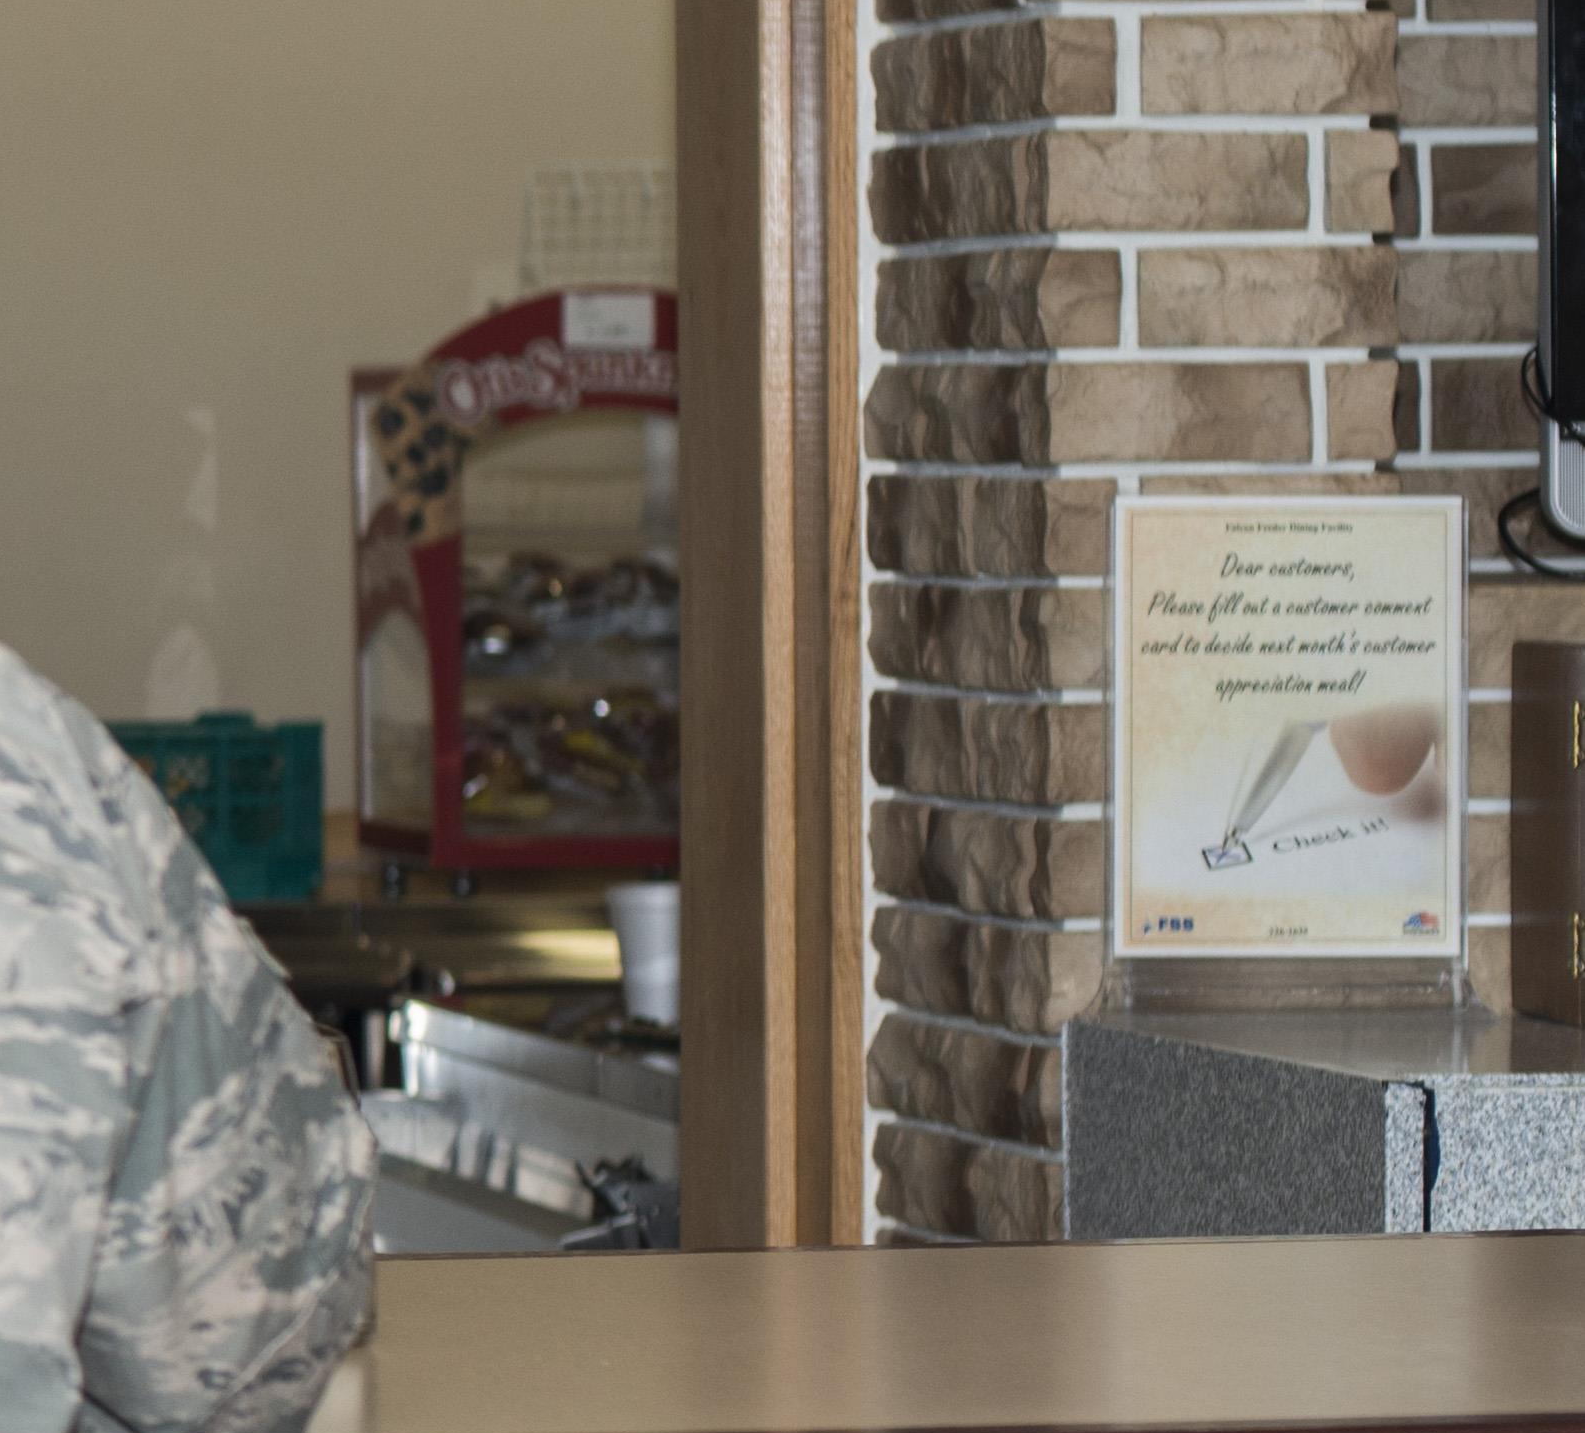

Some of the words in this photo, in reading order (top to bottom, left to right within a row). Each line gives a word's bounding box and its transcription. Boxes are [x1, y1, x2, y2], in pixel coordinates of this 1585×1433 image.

[1221, 552, 1263, 578] Dear
[1269, 557, 1355, 582] customers,
[1148, 591, 1205, 616] Please
[1207, 591, 1245, 623] fill
[1243, 596, 1269, 615] out
[1272, 602, 1281, 615] a
[1286, 596, 1359, 615] customer
[1364, 595, 1433, 615] comment
[1141, 631, 1185, 654] card
[1184, 634, 1201, 654] to
[1204, 631, 1254, 654] decide
[1259, 634, 1296, 654] next
[1298, 628, 1360, 654] month's
[1363, 634, 1436, 654] customer
[1215, 673, 1313, 703] appreciation
[1317, 667, 1367, 694] meal!
[1272, 825, 1355, 854] Check
